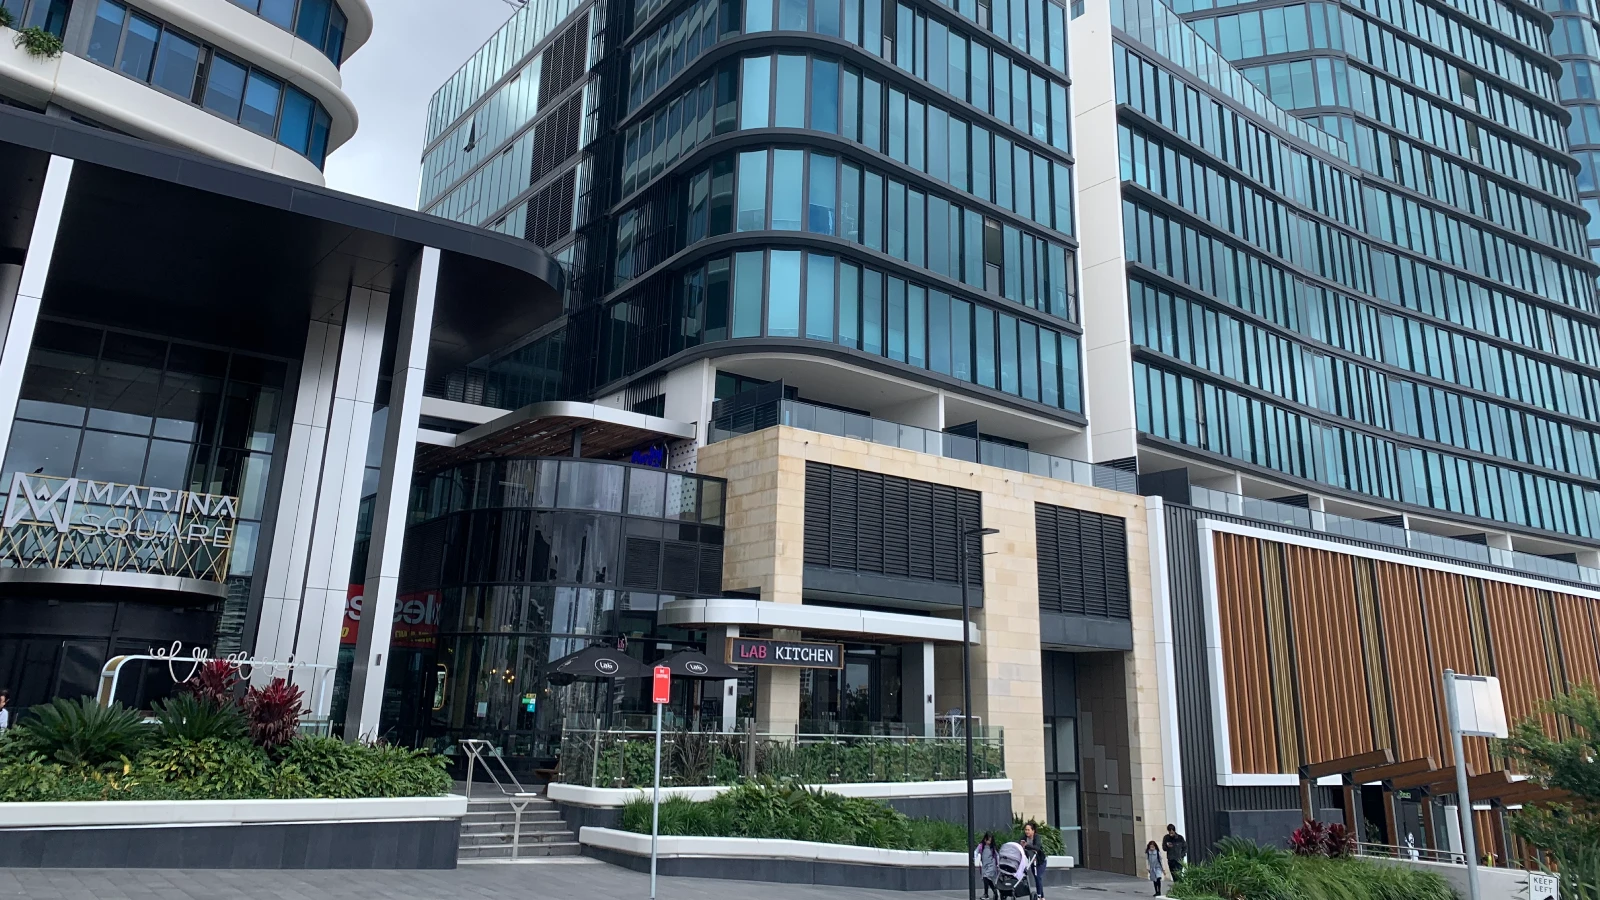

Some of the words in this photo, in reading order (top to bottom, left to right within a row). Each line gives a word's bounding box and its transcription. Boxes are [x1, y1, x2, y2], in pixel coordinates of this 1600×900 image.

[84, 480, 236, 518] MARINA
[78, 514, 232, 547] SQUARE
[740, 644, 767, 659] LAB
[775, 646, 833, 662] KITCHEN
[1533, 877, 1553, 885] KEEP
[1534, 885, 1552, 893] LEFT
